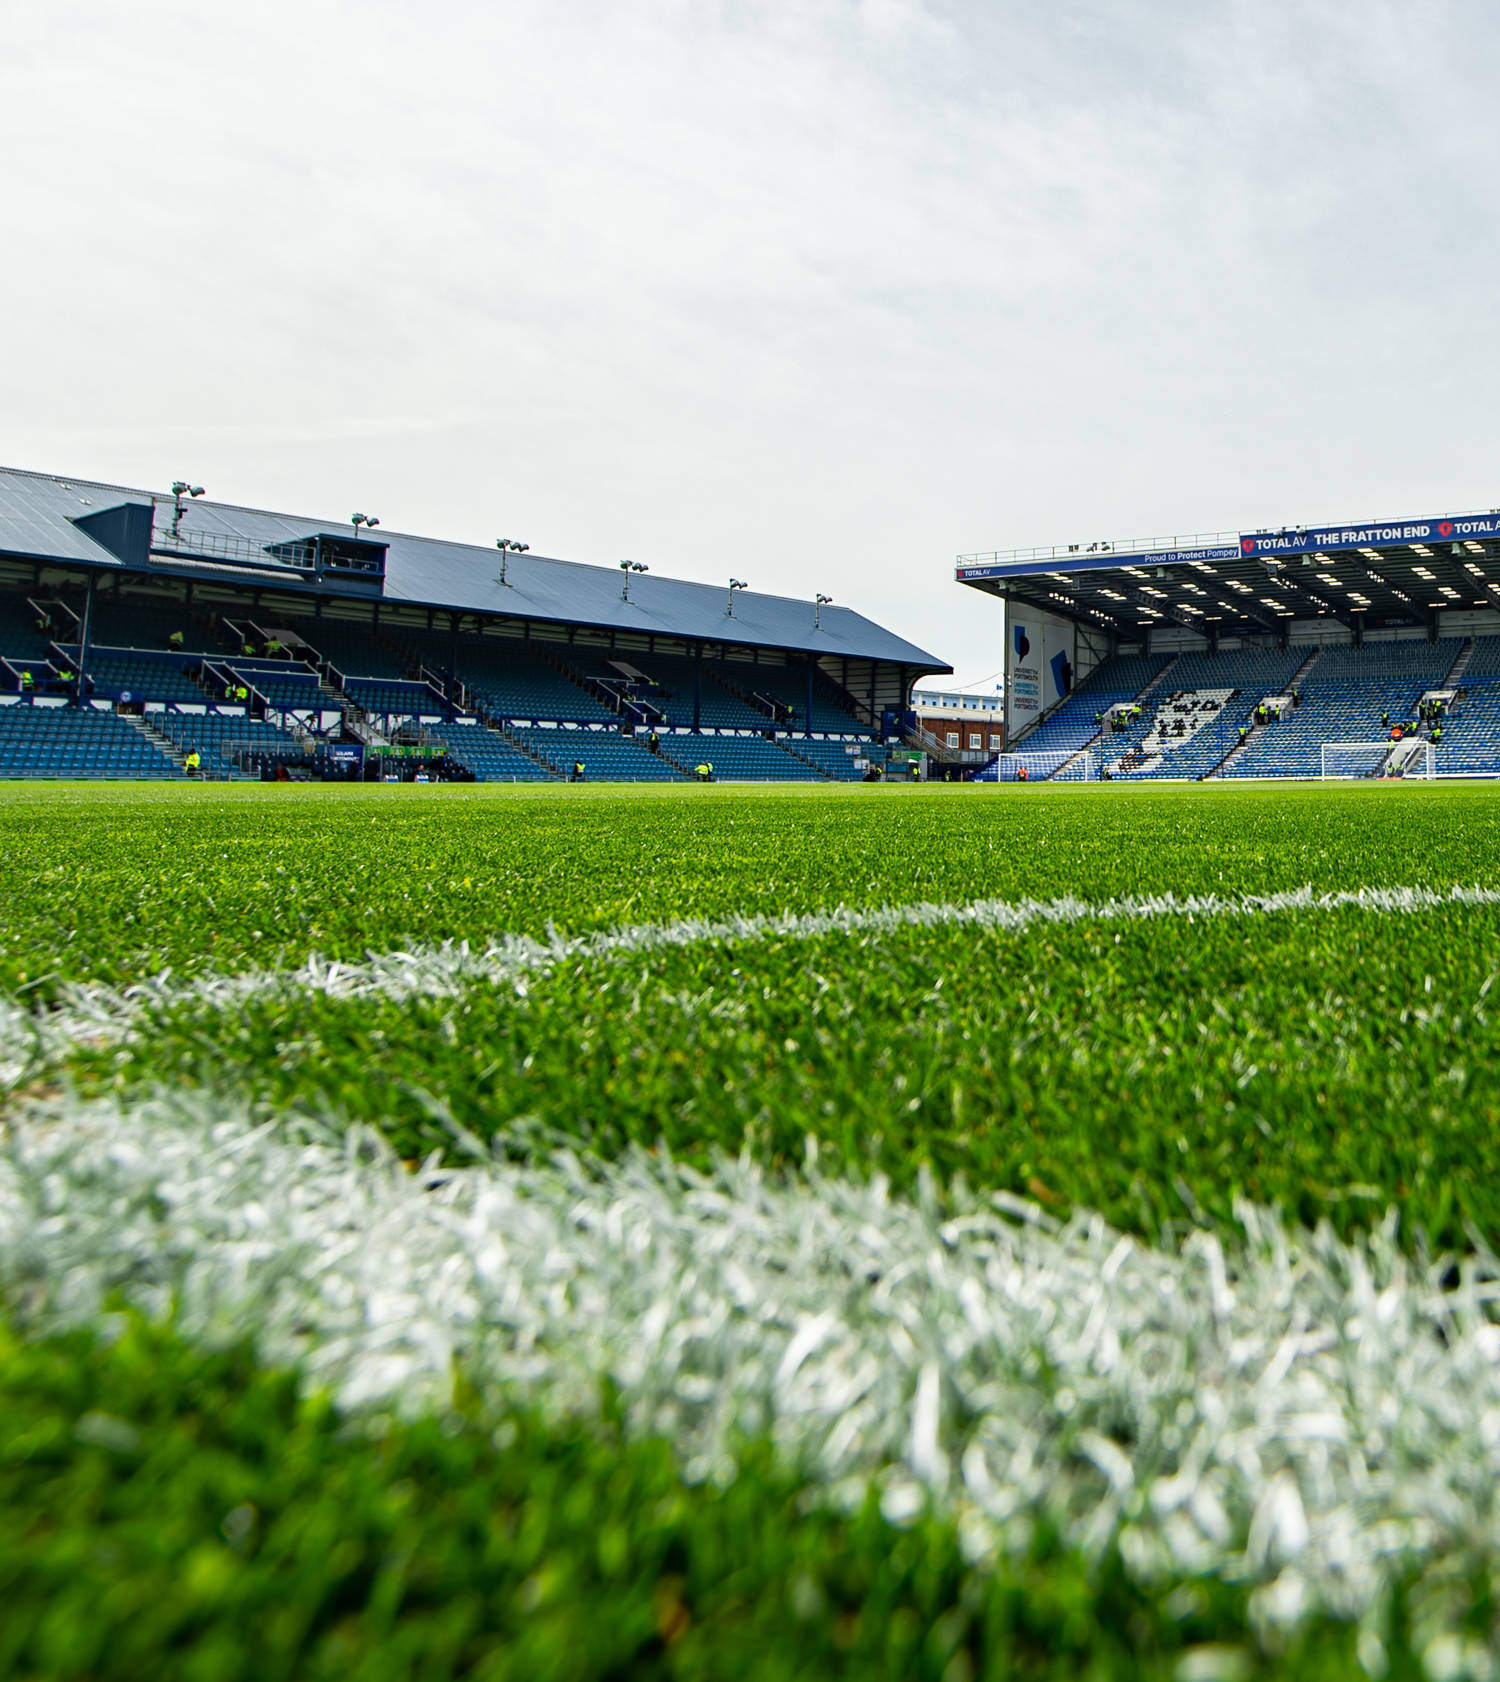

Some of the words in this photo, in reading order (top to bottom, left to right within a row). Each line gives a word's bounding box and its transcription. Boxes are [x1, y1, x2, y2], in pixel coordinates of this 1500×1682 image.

[1314, 532, 1340, 545] THE
[1341, 527, 1402, 543] FRATTON
[1403, 525, 1430, 538] END
[1145, 552, 1166, 563] Proud
[1168, 552, 1176, 561] to
[1177, 549, 1206, 561] Protect
[1207, 548, 1238, 559] Pompey
